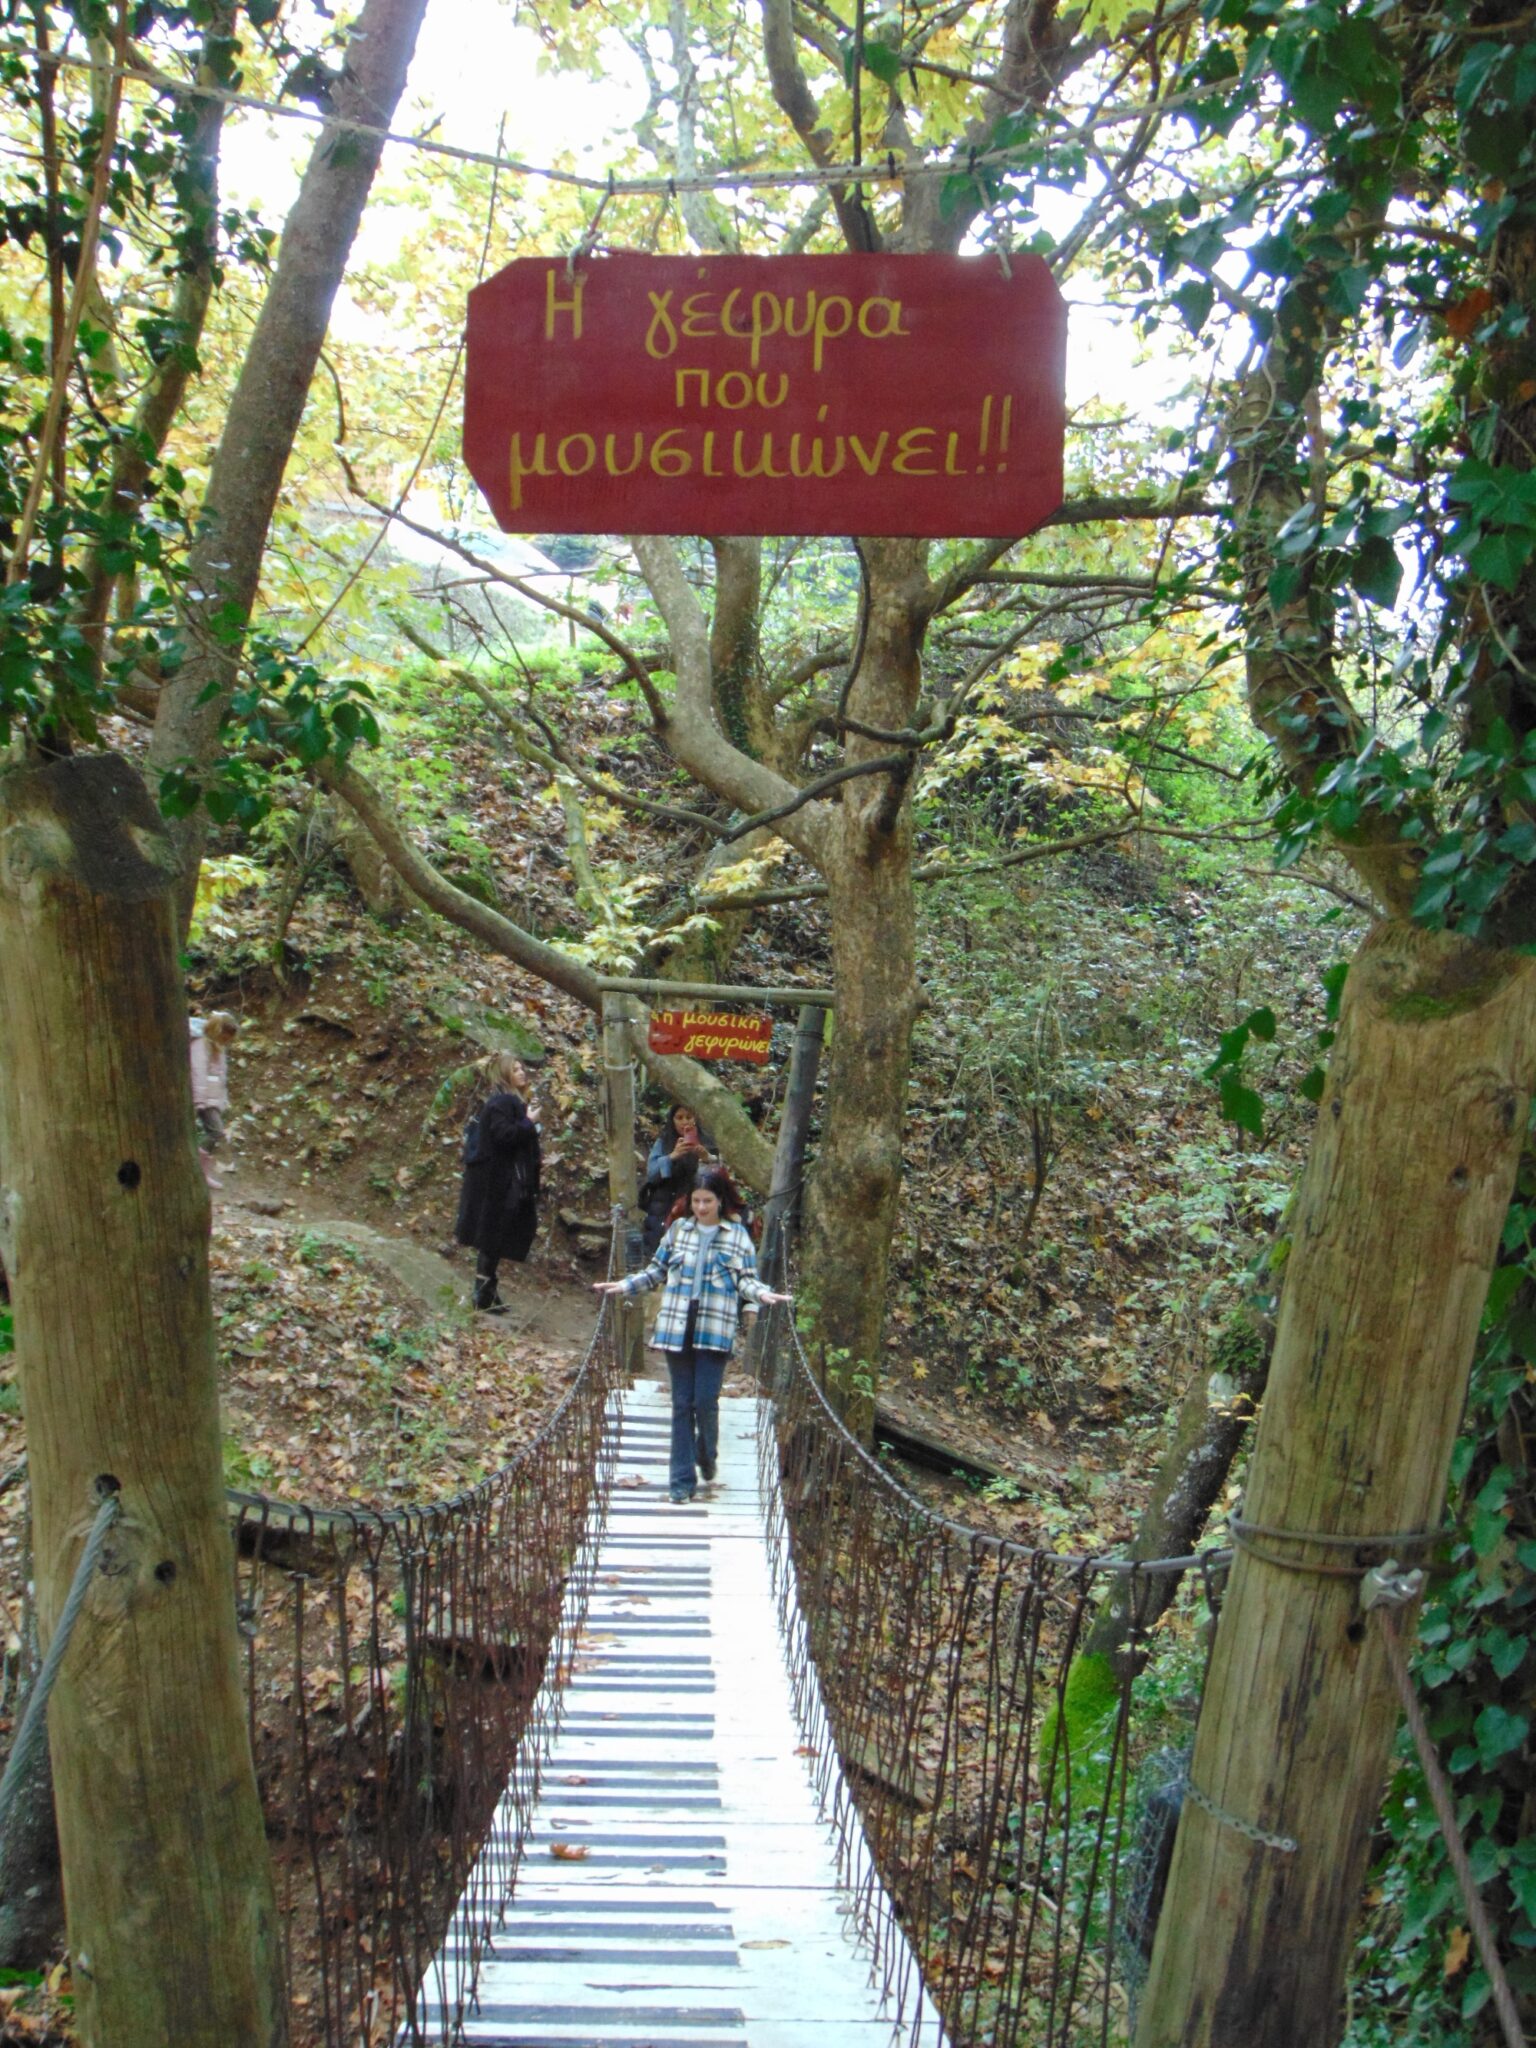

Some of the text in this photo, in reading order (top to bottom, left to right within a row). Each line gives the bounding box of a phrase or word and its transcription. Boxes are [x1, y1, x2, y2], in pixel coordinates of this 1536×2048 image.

[545, 269, 910, 372] Η γέφυρα
[676, 369, 789, 409] που
[683, 1012, 760, 1031] μουσική
